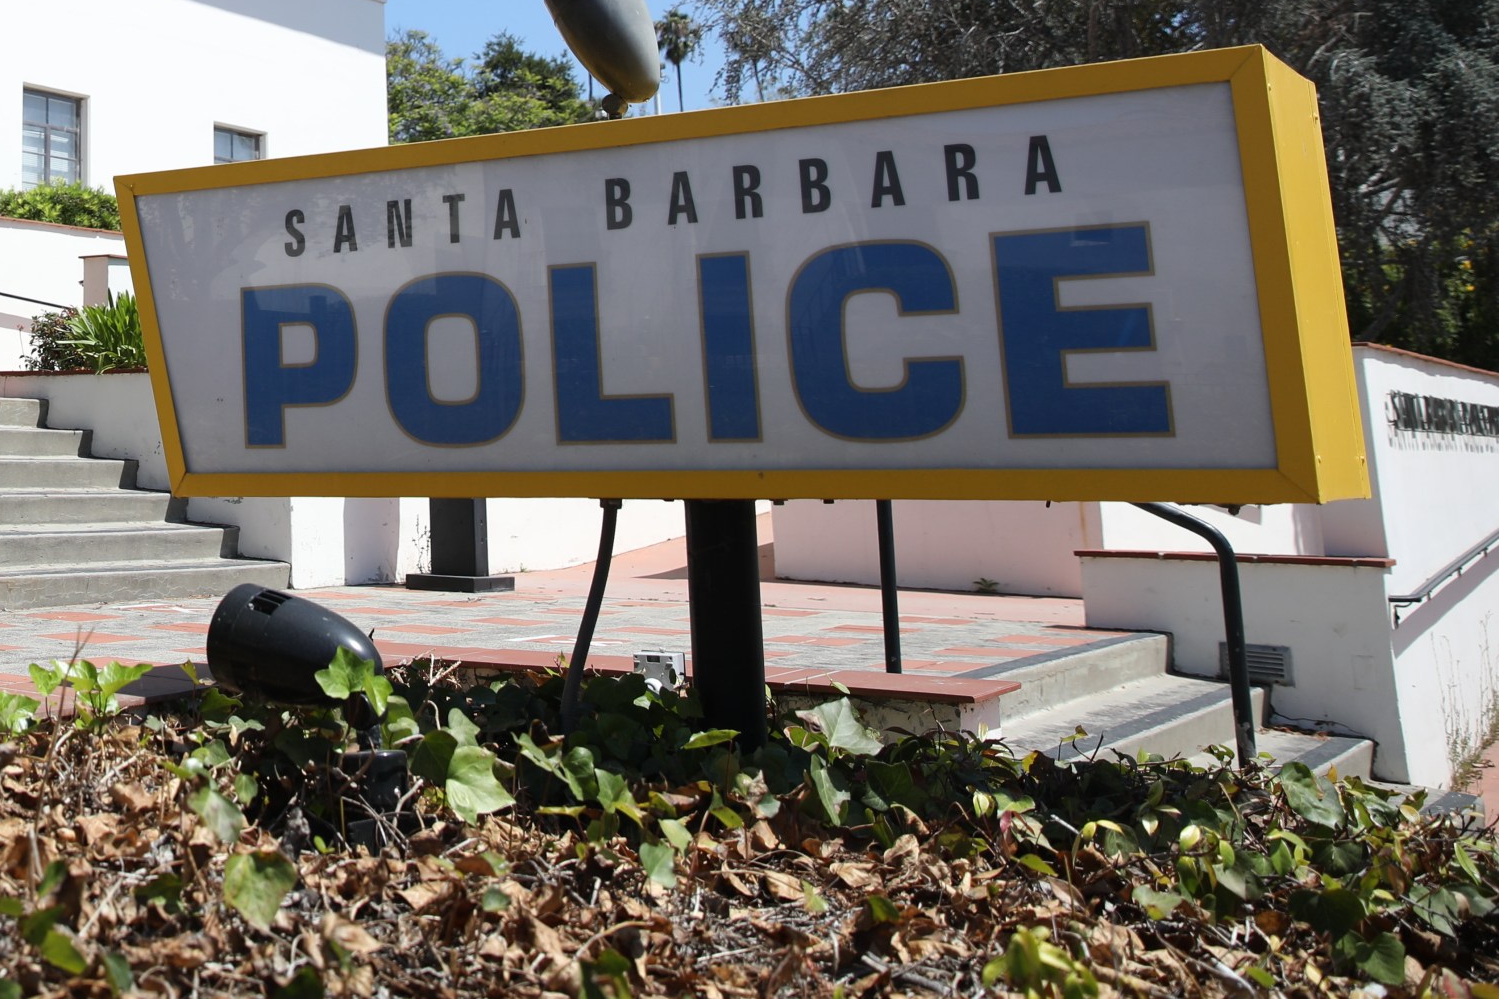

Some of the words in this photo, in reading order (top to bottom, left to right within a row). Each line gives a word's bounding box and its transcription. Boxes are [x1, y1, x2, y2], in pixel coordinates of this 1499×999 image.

[283, 187, 523, 257] SANTA
[605, 134, 1063, 231] BARBARA
[240, 220, 1177, 450] POLICE
